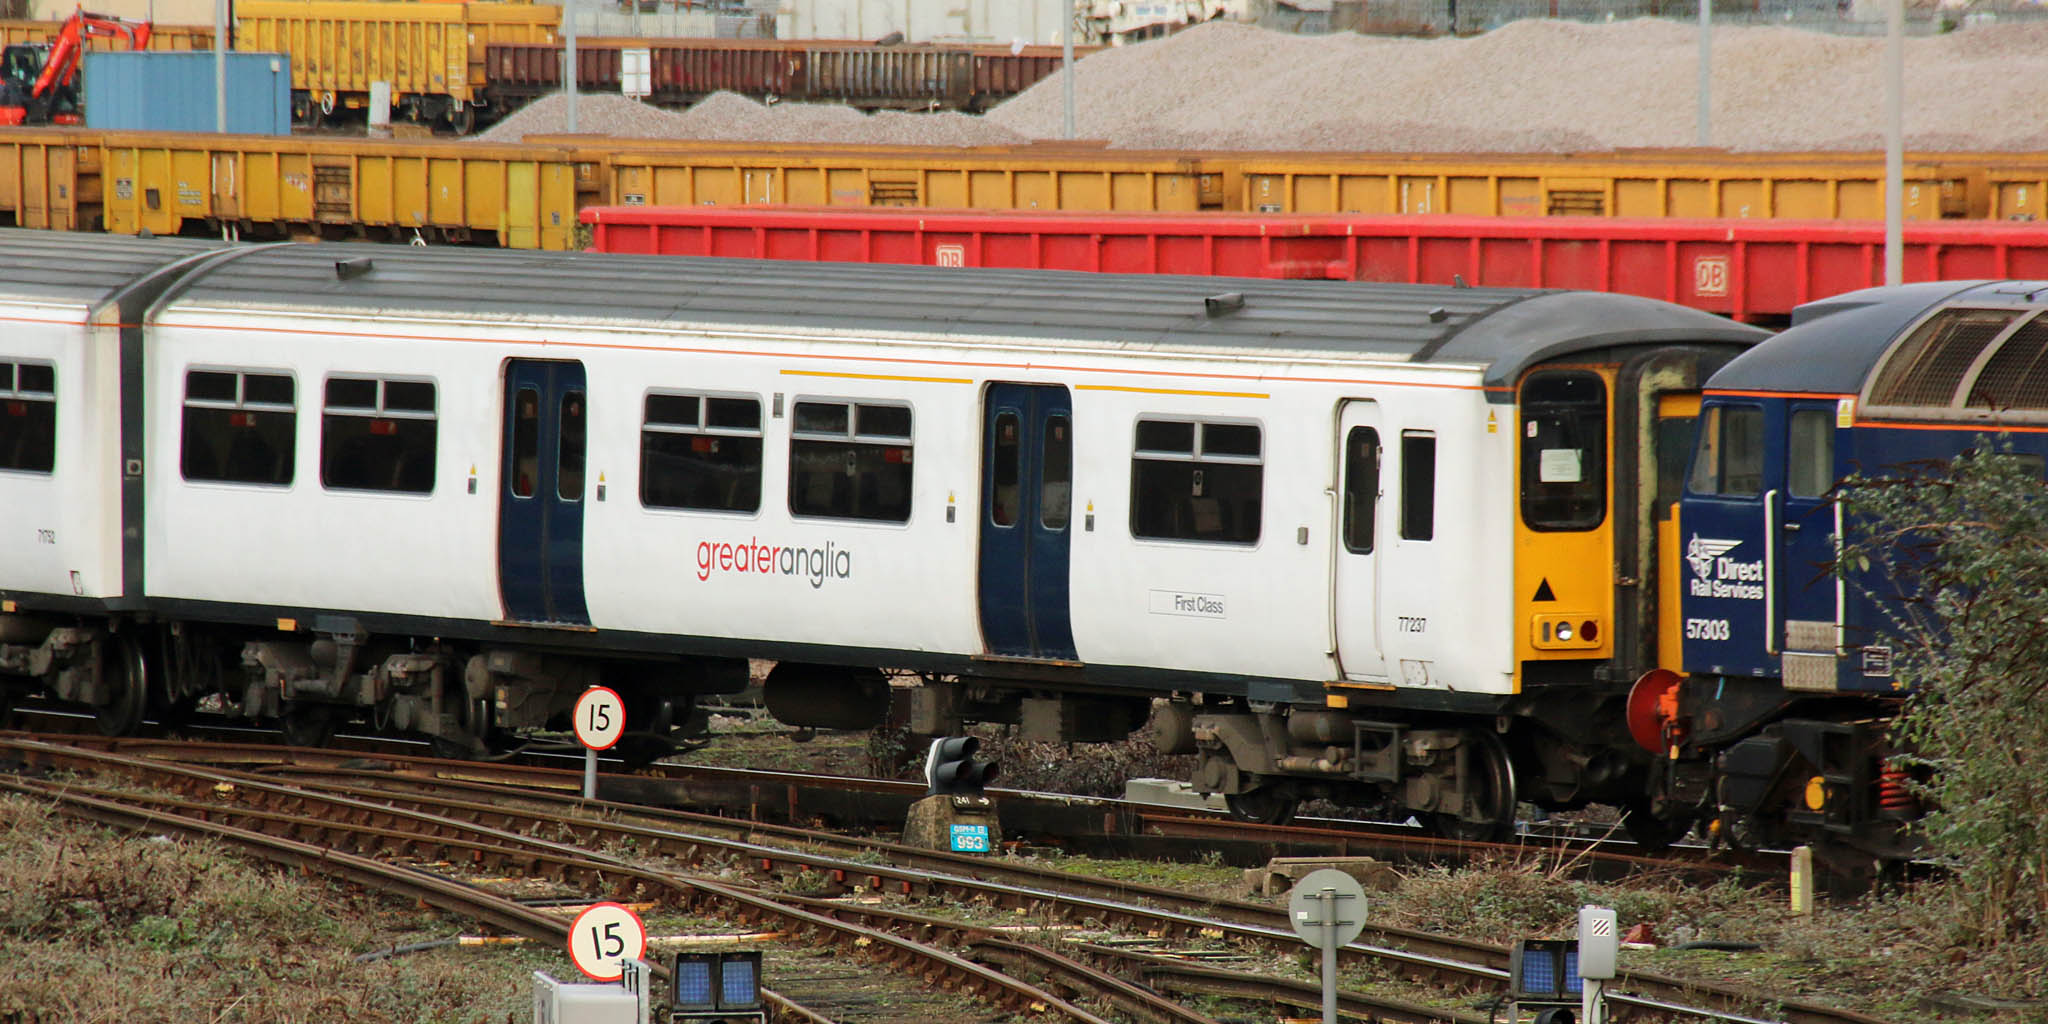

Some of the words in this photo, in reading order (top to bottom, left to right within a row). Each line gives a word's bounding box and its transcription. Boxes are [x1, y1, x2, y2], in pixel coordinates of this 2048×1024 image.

[1699, 262, 1724, 289] DB
[697, 536, 850, 589] greateranglia
[1717, 557, 1764, 581] Direct
[1691, 579, 1712, 597] Rail
[1712, 580, 1764, 600] Services
[1175, 595, 1196, 612] First
[1197, 596, 1224, 614] Class
[1398, 616, 1427, 633] 77237
[1686, 618, 1730, 641] 57303
[589, 703, 610, 731] 15
[957, 835, 983, 849] 993
[591, 921, 625, 961] 15
